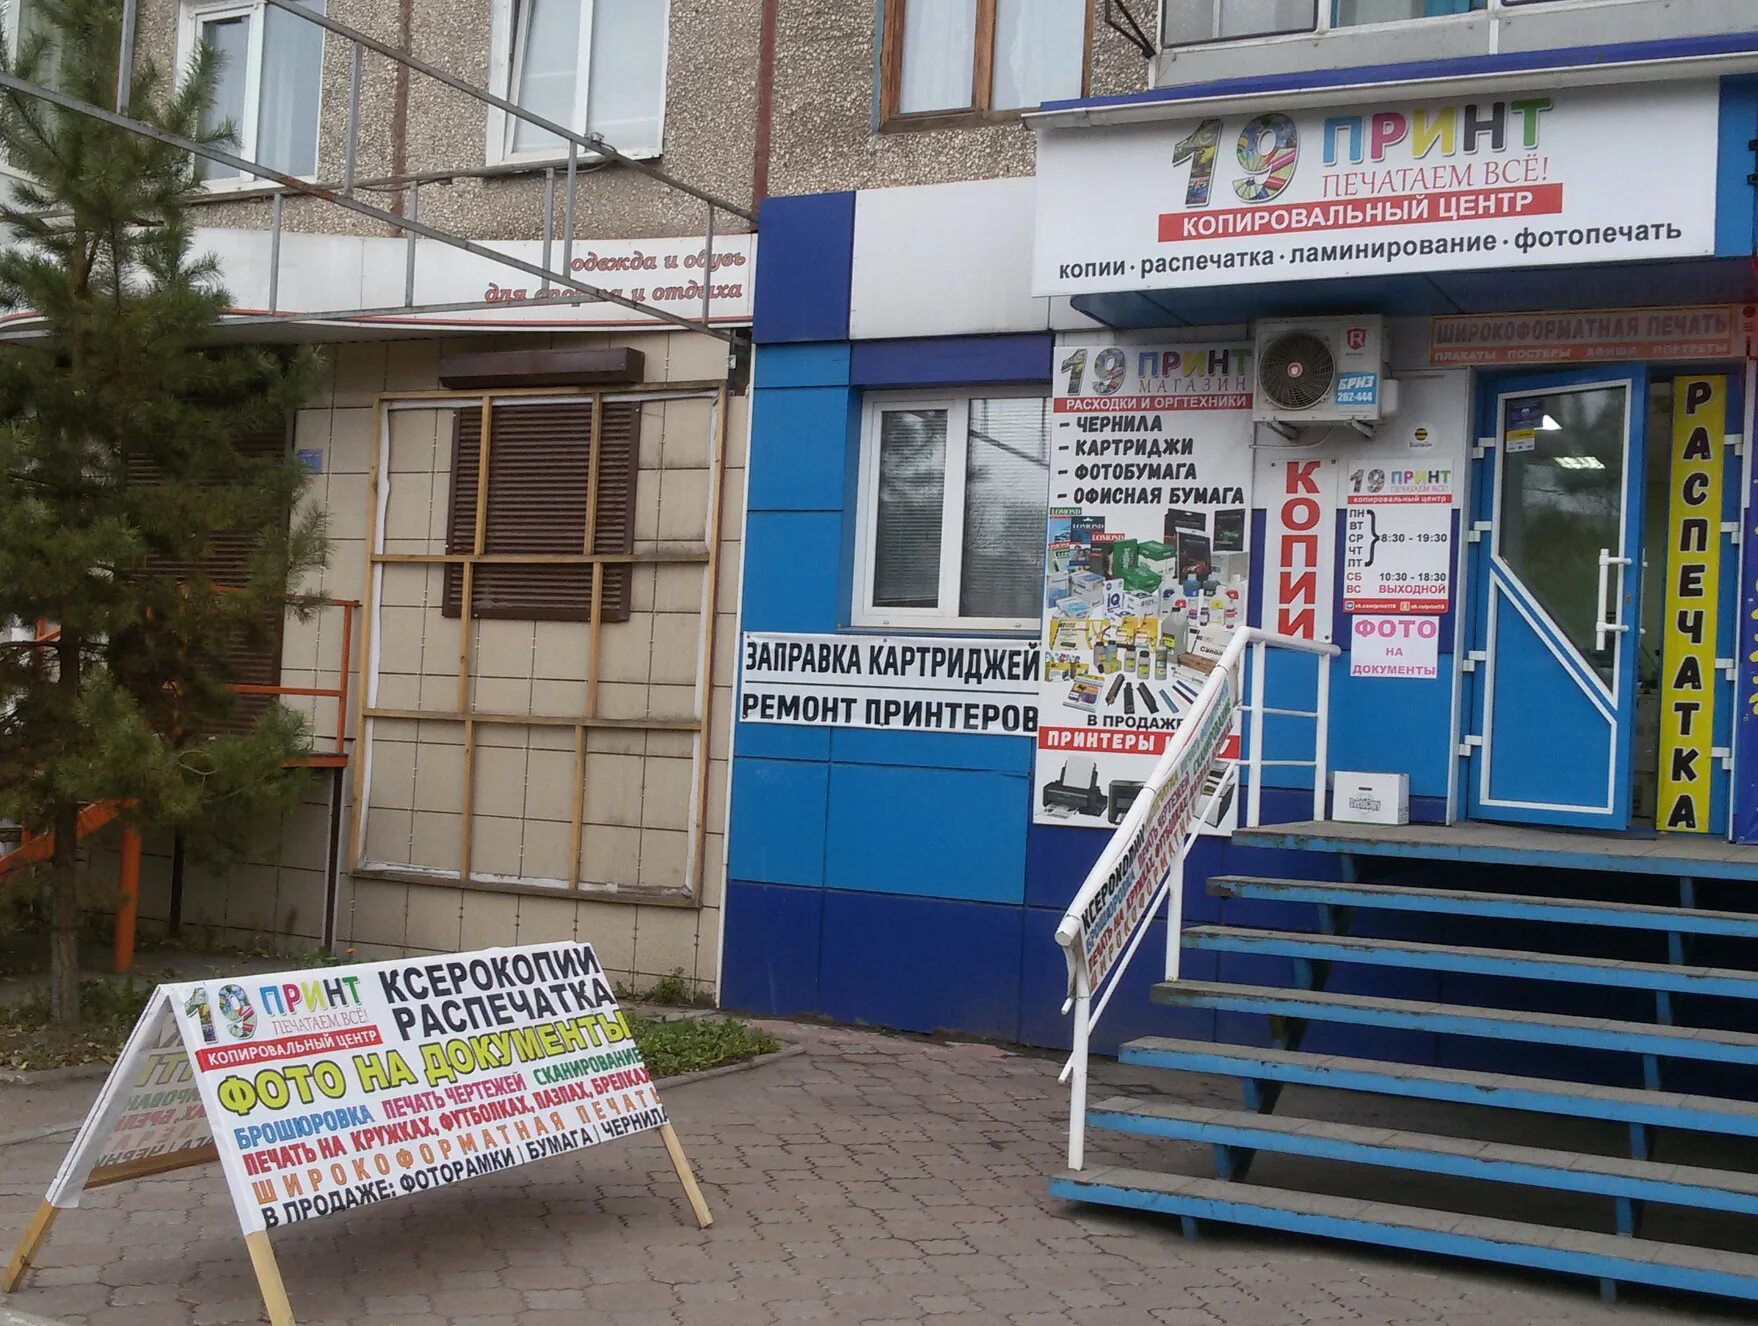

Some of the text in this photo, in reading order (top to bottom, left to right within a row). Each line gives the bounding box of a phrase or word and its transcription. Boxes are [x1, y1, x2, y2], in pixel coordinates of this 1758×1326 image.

[1171, 97, 1555, 207] 19 ПРИНТ
[1322, 155, 1550, 199] ПЕЧАТАЕМ ВСЁ!
[1182, 190, 1534, 239] КОПИРОВАЛЬНЫЙ ЦЕНТР
[571, 249, 746, 272] одежда и обувь
[1058, 220, 1683, 280] копии распечатка ламинирование фотопечать
[631, 287, 645, 302] и
[1435, 312, 1729, 345] ШИРОКОФОРМАТНАЯ ПЕЧАТЬ
[1507, 347, 1572, 360] ПОСТЕРЫ
[1060, 347, 1252, 396] 19 ПРИНТ
[1138, 376, 1247, 394] МАГАЗИН
[1337, 375, 1375, 391] БРИЗ
[1066, 395, 1247, 412] РАСХОДКИ И ОРГТЕХНИКИ
[1076, 415, 1163, 433] ЧЕРНИЛА
[1075, 437, 1194, 459] КАРТРИДЖИ
[1074, 462, 1197, 481] ФОТОБУМАГА
[1350, 469, 1451, 493] 19 ПРИНТ
[1073, 486, 1245, 505] ОФИСНАЯ БУМАГА
[1353, 495, 1447, 504] копировальный центр
[1349, 509, 1365, 518] ПН
[1350, 521, 1364, 530] ВТ
[1348, 534, 1364, 543] СР
[1380, 533, 1405, 543] 8:30
[1417, 533, 1448, 543] 19:30
[1278, 460, 1321, 640] КОПИИ
[1348, 546, 1363, 555] ЧТ
[1348, 558, 1363, 568] ПТ
[1346, 572, 1362, 581] СБ
[1379, 572, 1408, 582] 10:30
[1418, 572, 1447, 582] 18:30
[1346, 583, 1446, 595] ВС ВЫХОДНОЙ
[1666, 380, 1713, 830] РАСПЕЧАТКА
[1354, 619, 1437, 639] ФОТО
[745, 640, 1040, 685] ЗАПРАВКА КАРТРИДЖЕЙ
[1385, 647, 1404, 657] НА
[1352, 664, 1436, 676] ДОКУМЕНТЫ
[742, 692, 1039, 733] РЕМОНТ ПРИНТЕРОВ
[1087, 715, 1097, 727] В
[1047, 730, 1155, 751] ПРИНТЕРЫ
[378, 945, 600, 1004] КСЕРОКОПИИ
[184, 976, 361, 1045] 19 ПРИНТ
[392, 977, 616, 1041] РАСПЕЧАТКА
[272, 1008, 370, 1036] ПЕЧАТАЕМ ВСЁ!
[208, 1029, 377, 1066] КОПИРОВАЛЬНЫЙ ЦЕНТР
[218, 1059, 347, 1117] ФОТО
[352, 1049, 419, 1093] НА
[419, 1009, 634, 1087] ДОКУМЕНТЫ
[233, 1104, 375, 1150] БРОШЮРОВКА
[382, 1090, 446, 1121] ПЕЧАТЬ
[445, 1070, 528, 1103] ЧЕРТЕЖЕЙ
[533, 1046, 641, 1086] СКАНИРОВАНИЕ
[242, 1142, 318, 1176] ПЕЧАТЬ
[316, 1135, 347, 1160] НА
[350, 1115, 440, 1152] КРУЖКАХ,
[252, 1111, 566, 1205] ШИРОКОФОРМАТНАЯ
[261, 1207, 280, 1229] В
[400, 1146, 516, 1194] ФОТОРАМКИ
[525, 1127, 594, 1161] БУМАГА
[603, 1105, 671, 1137] ЧЕРНИЛА
